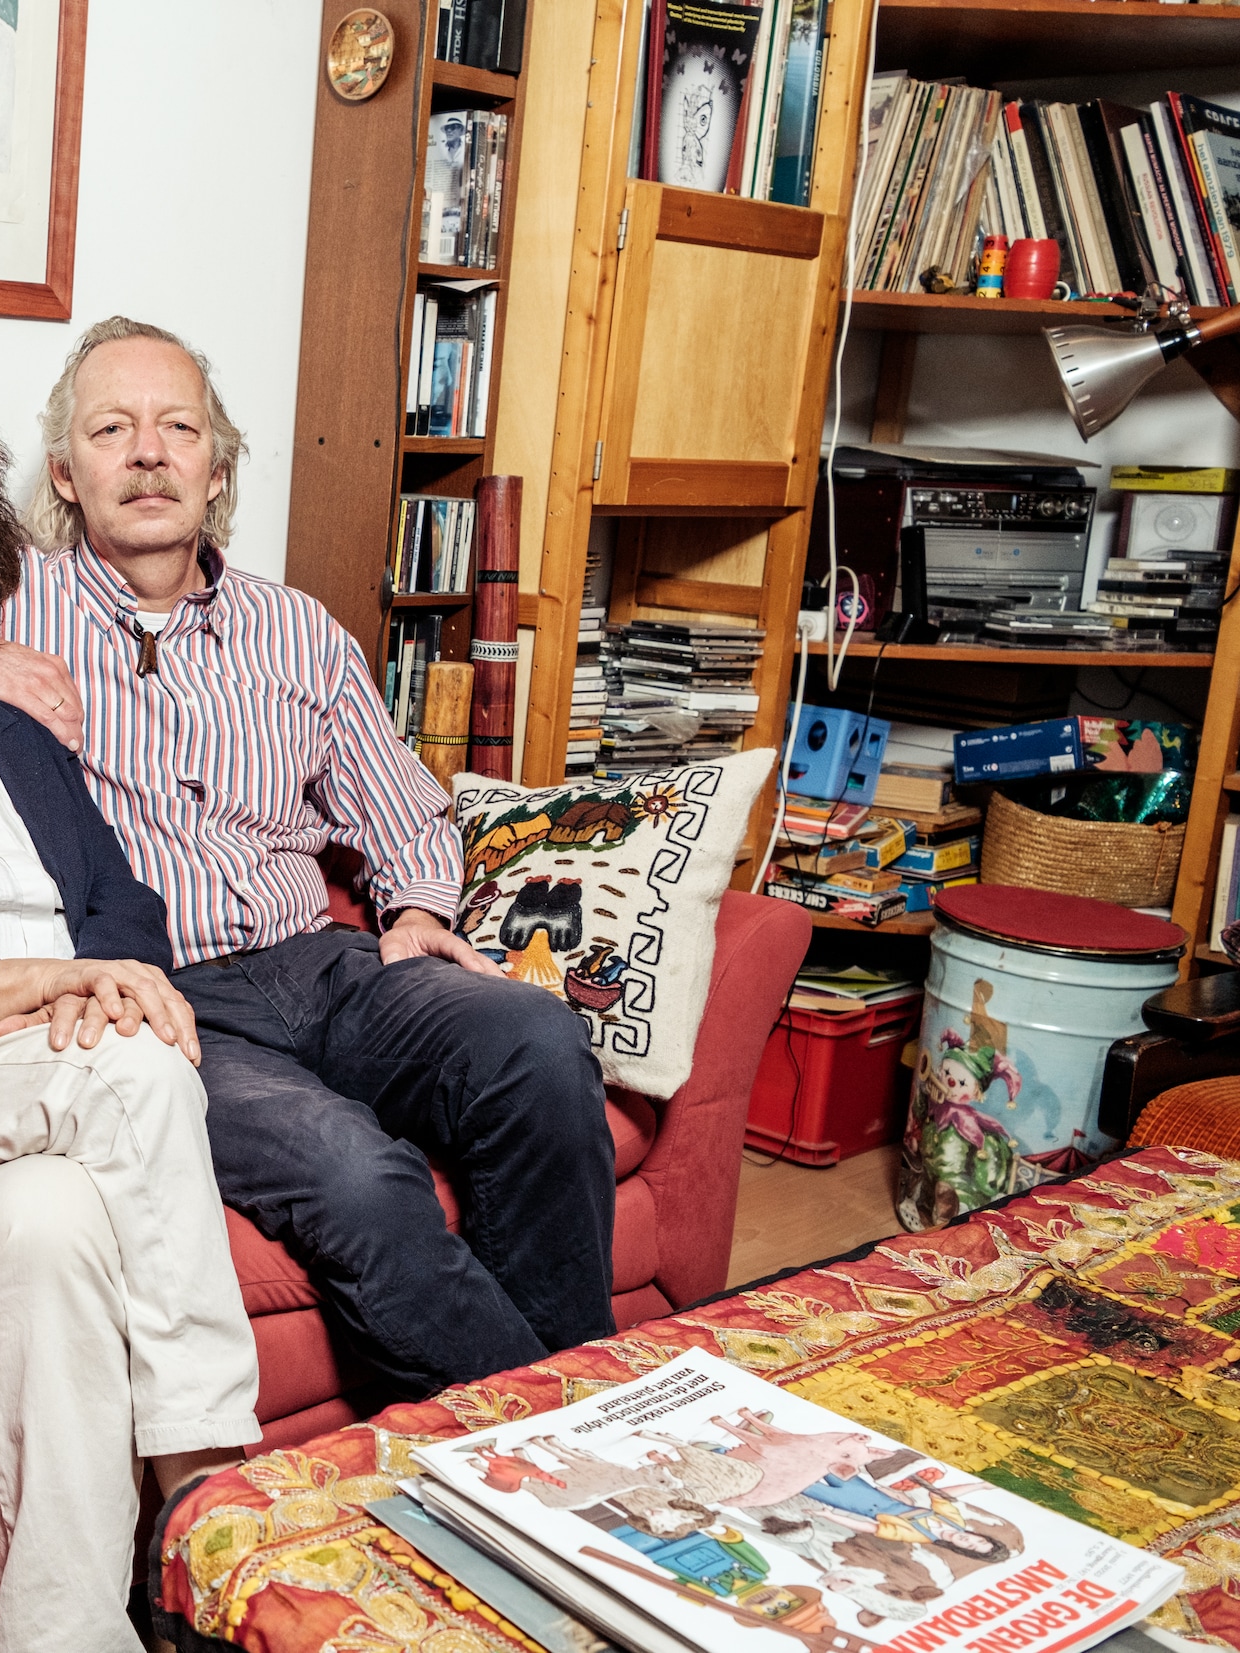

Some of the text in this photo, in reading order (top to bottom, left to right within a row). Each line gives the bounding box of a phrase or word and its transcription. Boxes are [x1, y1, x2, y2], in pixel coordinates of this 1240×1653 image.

[453, 29, 462, 57] TDK
[812, 48, 823, 97] COLOMBIA
[1142, 172, 1163, 240] RUSSIAN REVOLUTION
[1197, 143, 1235, 258] het aanzien van 1979
[571, 1374, 710, 1435] met de romantische idylle
[596, 1367, 695, 1413] van het platteland
[626, 1381, 726, 1427] Stemmen trekken
[964, 1578, 1117, 1653] DE GROENE
